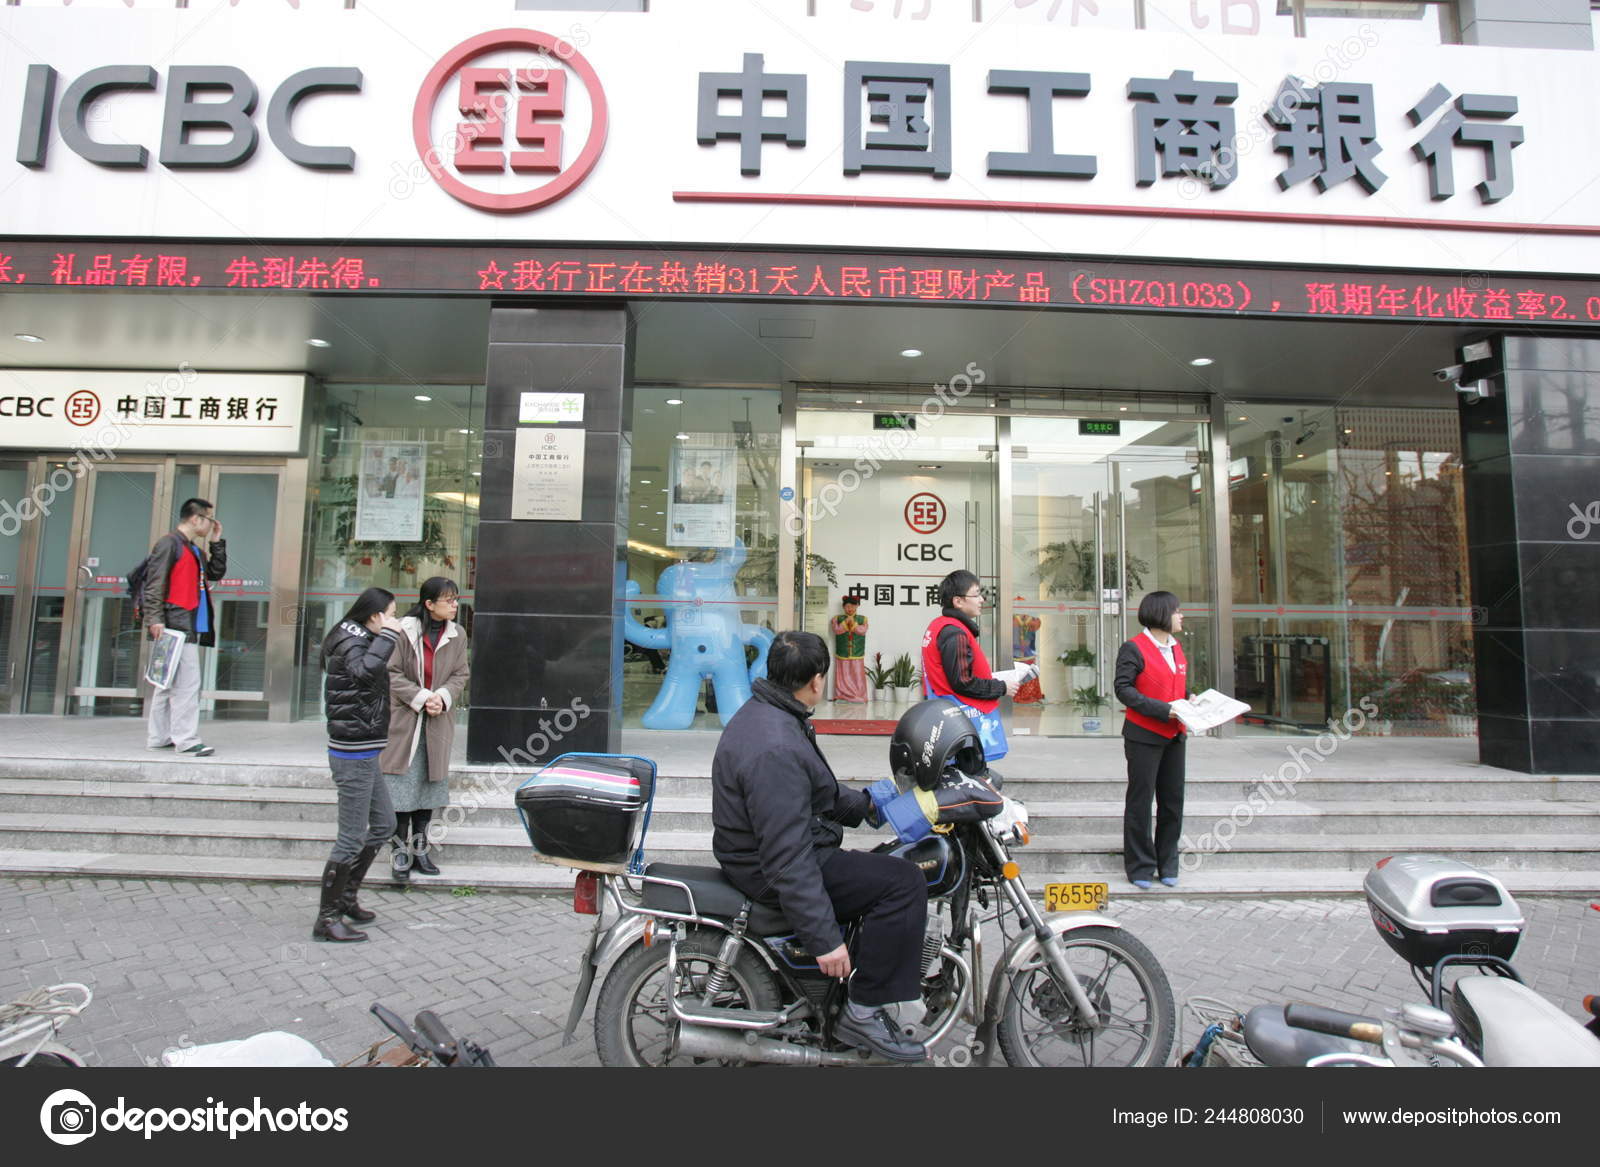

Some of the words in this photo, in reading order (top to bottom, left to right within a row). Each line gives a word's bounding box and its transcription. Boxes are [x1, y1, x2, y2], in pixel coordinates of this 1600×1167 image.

[16, 64, 362, 171] ICBC
[697, 52, 1524, 204] 中国工商银行
[117, 395, 277, 420] 中国工商银行
[898, 543, 953, 561] ICBC
[1049, 885, 1104, 904] 56558
